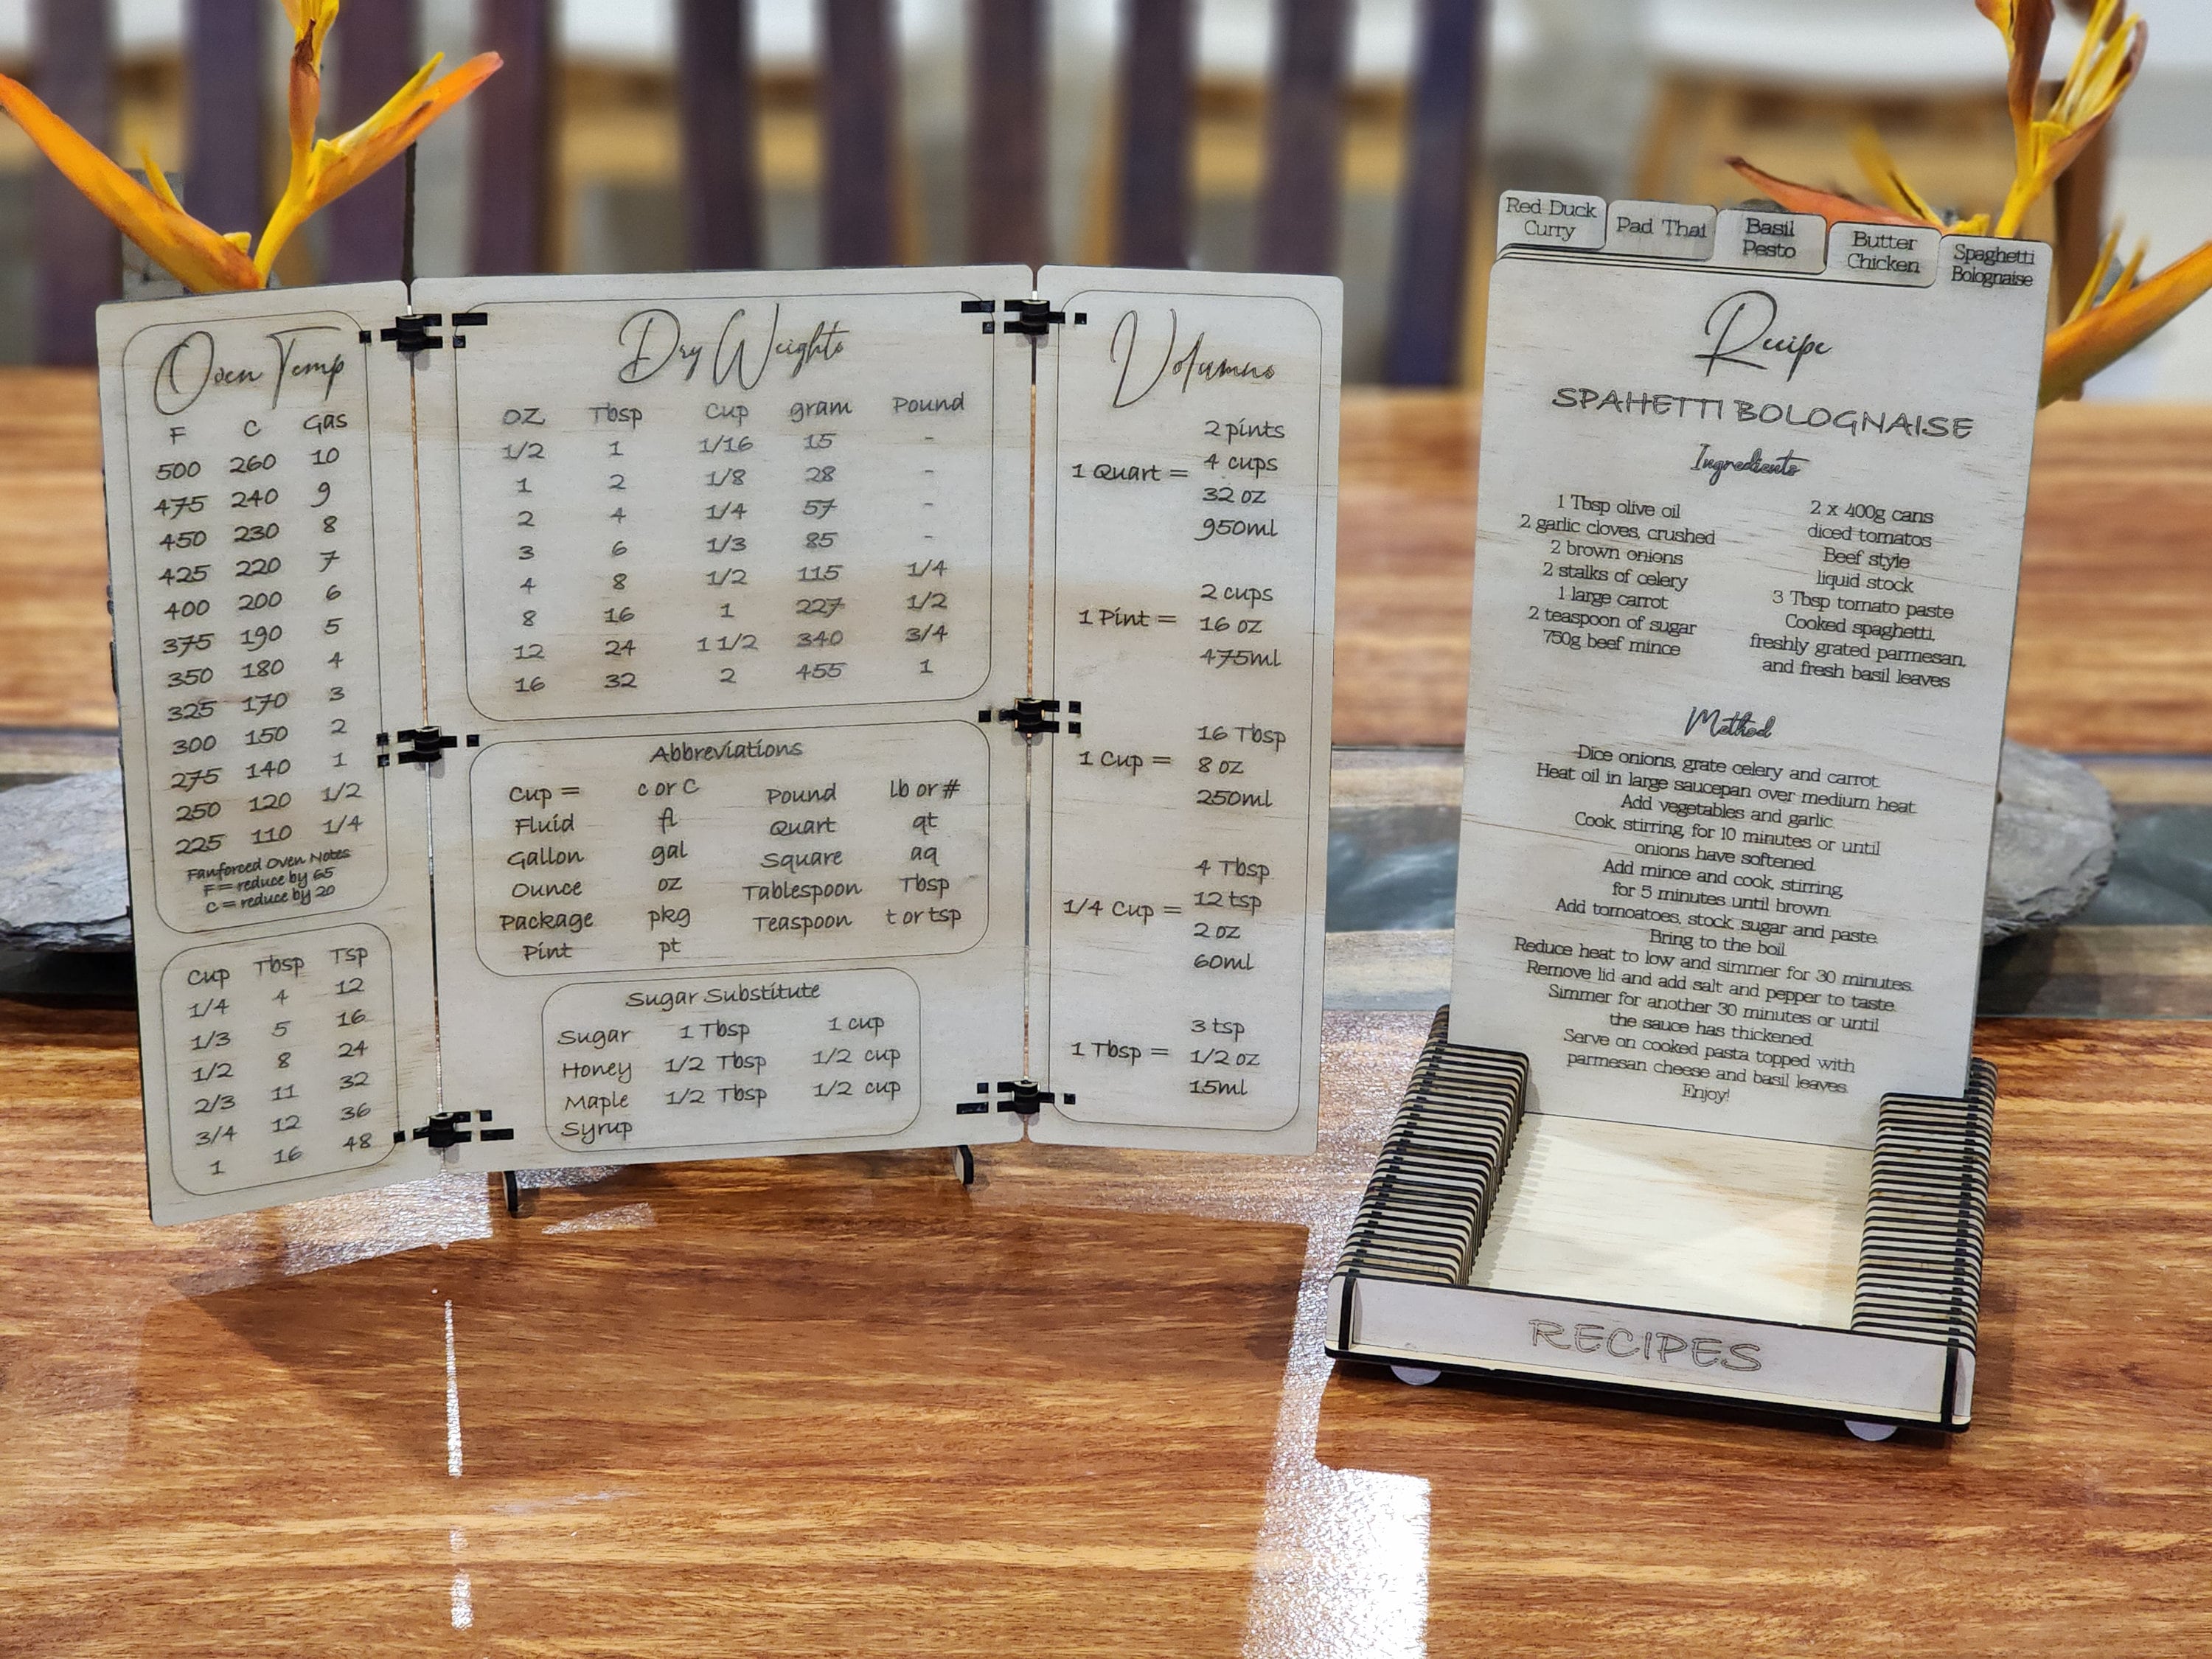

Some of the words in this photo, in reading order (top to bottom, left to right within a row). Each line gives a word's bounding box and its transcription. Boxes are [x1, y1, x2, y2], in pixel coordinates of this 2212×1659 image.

[1506, 198, 1543, 215] Red
[1548, 199, 1598, 218] Duck
[1524, 220, 1576, 243] Curry
[1615, 216, 1655, 235] Pad
[1661, 218, 1708, 239] Thai
[1745, 217, 1795, 238] Basil
[1851, 230, 1919, 251] Butter
[1742, 238, 1797, 260] Pesto
[1847, 252, 1921, 275] Chicken
[1952, 243, 2035, 267] Spaghetti
[1950, 265, 2034, 289] Bolognaise
[617, 308, 703, 384] Dry
[712, 302, 850, 392] Weights
[1693, 290, 1834, 383] Recipe
[153, 330, 263, 416] Oven
[265, 325, 345, 410] Temp
[588, 402, 643, 430] Tbsp
[790, 400, 853, 423] gram
[891, 391, 965, 414] Pound
[1551, 387, 1724, 420] SPAHETTI
[1733, 399, 1975, 439] BOLOGNAISE
[169, 426, 187, 445] F
[243, 419, 262, 438] C
[302, 413, 348, 436] Gas
[155, 460, 201, 481] 500
[229, 453, 276, 474] 260
[308, 447, 340, 466] 10
[1203, 453, 1220, 470] 4
[1228, 456, 1279, 480] cups
[1691, 443, 1809, 485] Ingredients
[153, 495, 209, 521] 475
[231, 487, 279, 509] 240
[310, 481, 331, 509] 9
[1557, 493, 1565, 509] 1
[1570, 493, 1611, 517] Tbsp
[1616, 498, 1656, 517] olive
[1660, 503, 1681, 519] oil
[1809, 499, 1822, 515] 2
[1826, 504, 1840, 517] x
[1843, 502, 1887, 524] 400g
[1891, 509, 1935, 524] cans
[159, 529, 208, 552] 450
[232, 522, 280, 544] 230
[322, 515, 338, 534] 8
[1193, 518, 1279, 542] 950ml
[1822, 546, 1865, 566] Beef
[1868, 552, 1911, 572] style
[519, 577, 537, 595] 4
[612, 572, 628, 591] 8
[705, 568, 748, 586] 1/2
[797, 564, 844, 582] 115
[906, 559, 948, 577] 1/4
[1542, 561, 1554, 577] 2
[1558, 564, 1609, 582] stalks
[1613, 568, 1633, 584] of
[1636, 571, 1689, 593] celery
[1815, 569, 1860, 591] liquid
[1865, 576, 1914, 594] stock
[521, 609, 538, 627] 8
[603, 606, 636, 624] 16
[719, 602, 735, 619] 1
[795, 597, 846, 619] 227
[906, 591, 948, 612] 1/2
[1543, 628, 1582, 651] 750g
[1587, 632, 1625, 651] beef
[1627, 639, 1681, 657] mince
[1199, 648, 1282, 669] 475ml
[1761, 658, 1795, 675] and
[1798, 660, 1846, 679] fresh
[1851, 664, 1891, 684] basil
[1895, 668, 1951, 689] leaves
[1683, 706, 1776, 739] Method
[648, 738, 804, 764] Abbreviations
[1197, 726, 1228, 742] 16
[1234, 723, 1287, 753] Tbsp
[1197, 756, 1213, 773] 8
[1195, 789, 1273, 808] 250ml
[175, 834, 222, 855] 225
[251, 824, 293, 845] 110
[322, 814, 364, 835] 1/4
[515, 813, 575, 836] Fluid
[658, 807, 678, 835] fl
[769, 816, 838, 837] Quart
[911, 811, 939, 836] qt
[187, 858, 261, 880] Fanforced
[267, 857, 306, 869] Oven
[310, 849, 351, 863] Notes
[507, 846, 585, 871] Gallon
[650, 840, 689, 866] gal
[759, 850, 844, 874] Square
[203, 884, 215, 897] F
[237, 873, 285, 891] reduce
[289, 870, 308, 888] by
[313, 866, 335, 881] 65
[511, 880, 583, 898] Ounce
[741, 880, 863, 905] Tablespoon
[898, 872, 950, 900] Tbsp
[206, 901, 220, 914] C
[240, 891, 289, 908] reduce
[292, 887, 311, 905] by
[316, 884, 335, 897] 20
[1062, 897, 1104, 917] 1/4
[1111, 900, 1155, 926] Cup
[1163, 905, 1183, 914] =
[522, 941, 574, 961] Pint
[658, 937, 682, 962] pt
[1193, 953, 1255, 971] 60ml
[187, 968, 231, 990] Cup
[253, 954, 305, 978] Tbsp
[188, 998, 230, 1019] 1/4
[271, 989, 289, 1006] 4
[334, 977, 365, 995] 12
[625, 991, 700, 1012] Sugar
[703, 981, 821, 1004] Substitute
[1548, 984, 1613, 1004] Simmer
[1617, 990, 1642, 1007] for
[1646, 997, 1714, 1015] another
[1717, 1001, 1738, 1017] 30
[1742, 1007, 1812, 1025] minutes
[1817, 1015, 1836, 1028] or
[1840, 1018, 1880, 1033] until
[562, 1062, 632, 1085] Honey
[664, 1055, 706, 1074] 1/2
[716, 1050, 767, 1076] Tbsp
[812, 1047, 852, 1065] 1/2
[864, 1048, 901, 1069] cup
[1071, 1041, 1086, 1057] 1
[1091, 1039, 1142, 1067] Tbsp
[1150, 1048, 1169, 1056] =
[1563, 1028, 1610, 1046] Serve
[1615, 1037, 1637, 1049] on
[1642, 1038, 1699, 1057] cooked
[1703, 1046, 1750, 1062] pasta
[1756, 1050, 1811, 1069] topped
[1816, 1057, 1856, 1074] with
[564, 1091, 630, 1116] Maple
[665, 1088, 706, 1105] 1/2
[715, 1083, 768, 1109] Tbsp
[813, 1079, 854, 1098] 1/2
[865, 1080, 901, 1102] cup
[1189, 1078, 1248, 1096] 15ml
[1681, 1082, 1731, 1105] Enjoy!
[560, 1121, 633, 1145] Syrup
[1528, 1318, 1761, 1371] RECIPES
